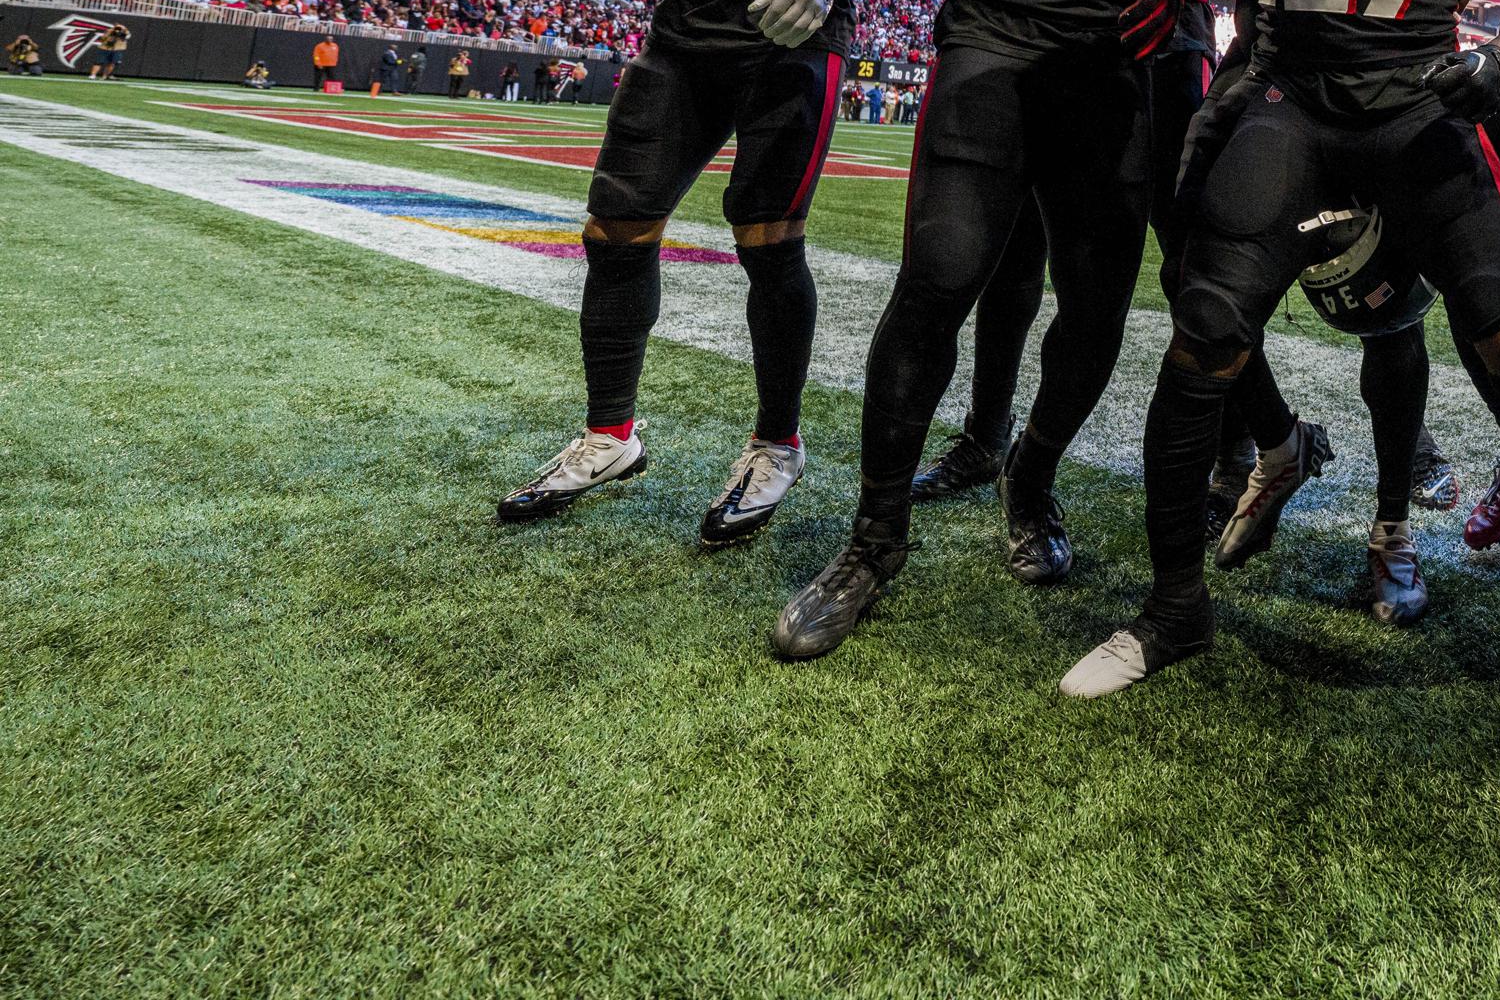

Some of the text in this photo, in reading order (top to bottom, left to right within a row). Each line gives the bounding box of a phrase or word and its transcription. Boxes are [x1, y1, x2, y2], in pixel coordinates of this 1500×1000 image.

[858, 61, 875, 78] 25
[888, 65, 903, 80] 3RD
[912, 67, 928, 83] 23
[1304, 267, 1350, 286] FALCONS
[1320, 285, 1360, 315] 34
